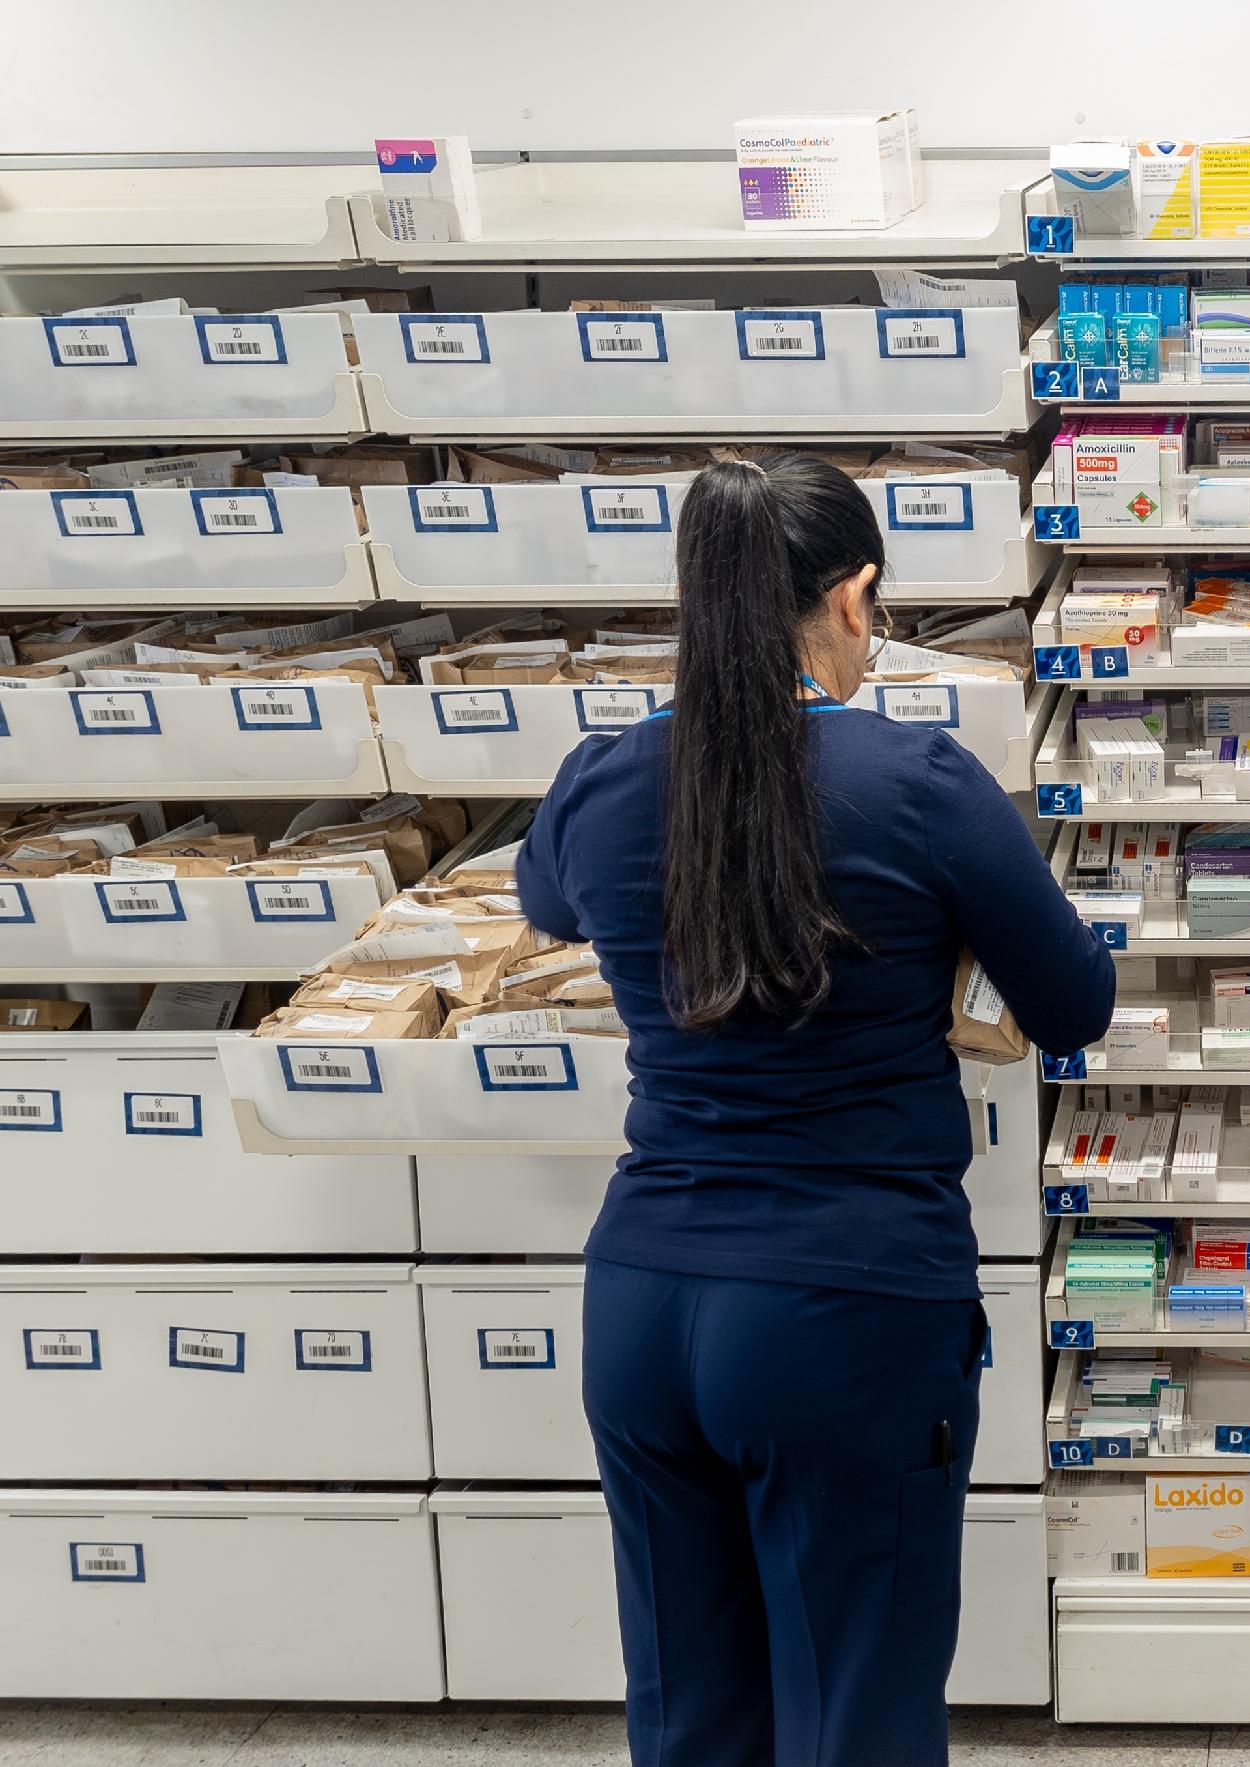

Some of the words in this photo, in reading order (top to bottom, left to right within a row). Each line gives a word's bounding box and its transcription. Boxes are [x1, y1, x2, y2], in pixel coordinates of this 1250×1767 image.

[1046, 226, 1055, 244] 1
[1050, 371, 1062, 389] 2
[1095, 378, 1108, 393] A
[1076, 444, 1136, 454] Amoxicillin
[1079, 459, 1115, 470] 500mg
[1077, 474, 1117, 484] Capsules
[1050, 514, 1063, 531] 3
[1065, 609, 1106, 618] Azathioprine
[1052, 656, 1064, 672] 4
[1104, 656, 1116, 670] B
[1054, 791, 1065, 808] 5
[1103, 929, 1115, 944] C
[1057, 1058, 1069, 1073] 7
[1060, 1193, 1072, 1208] 8
[1066, 1327, 1077, 1342] 9
[1230, 1431, 1243, 1444] D
[1060, 1447, 1081, 1461] 10
[1108, 1443, 1120, 1456] D
[1154, 1483, 1243, 1506] Laxido
